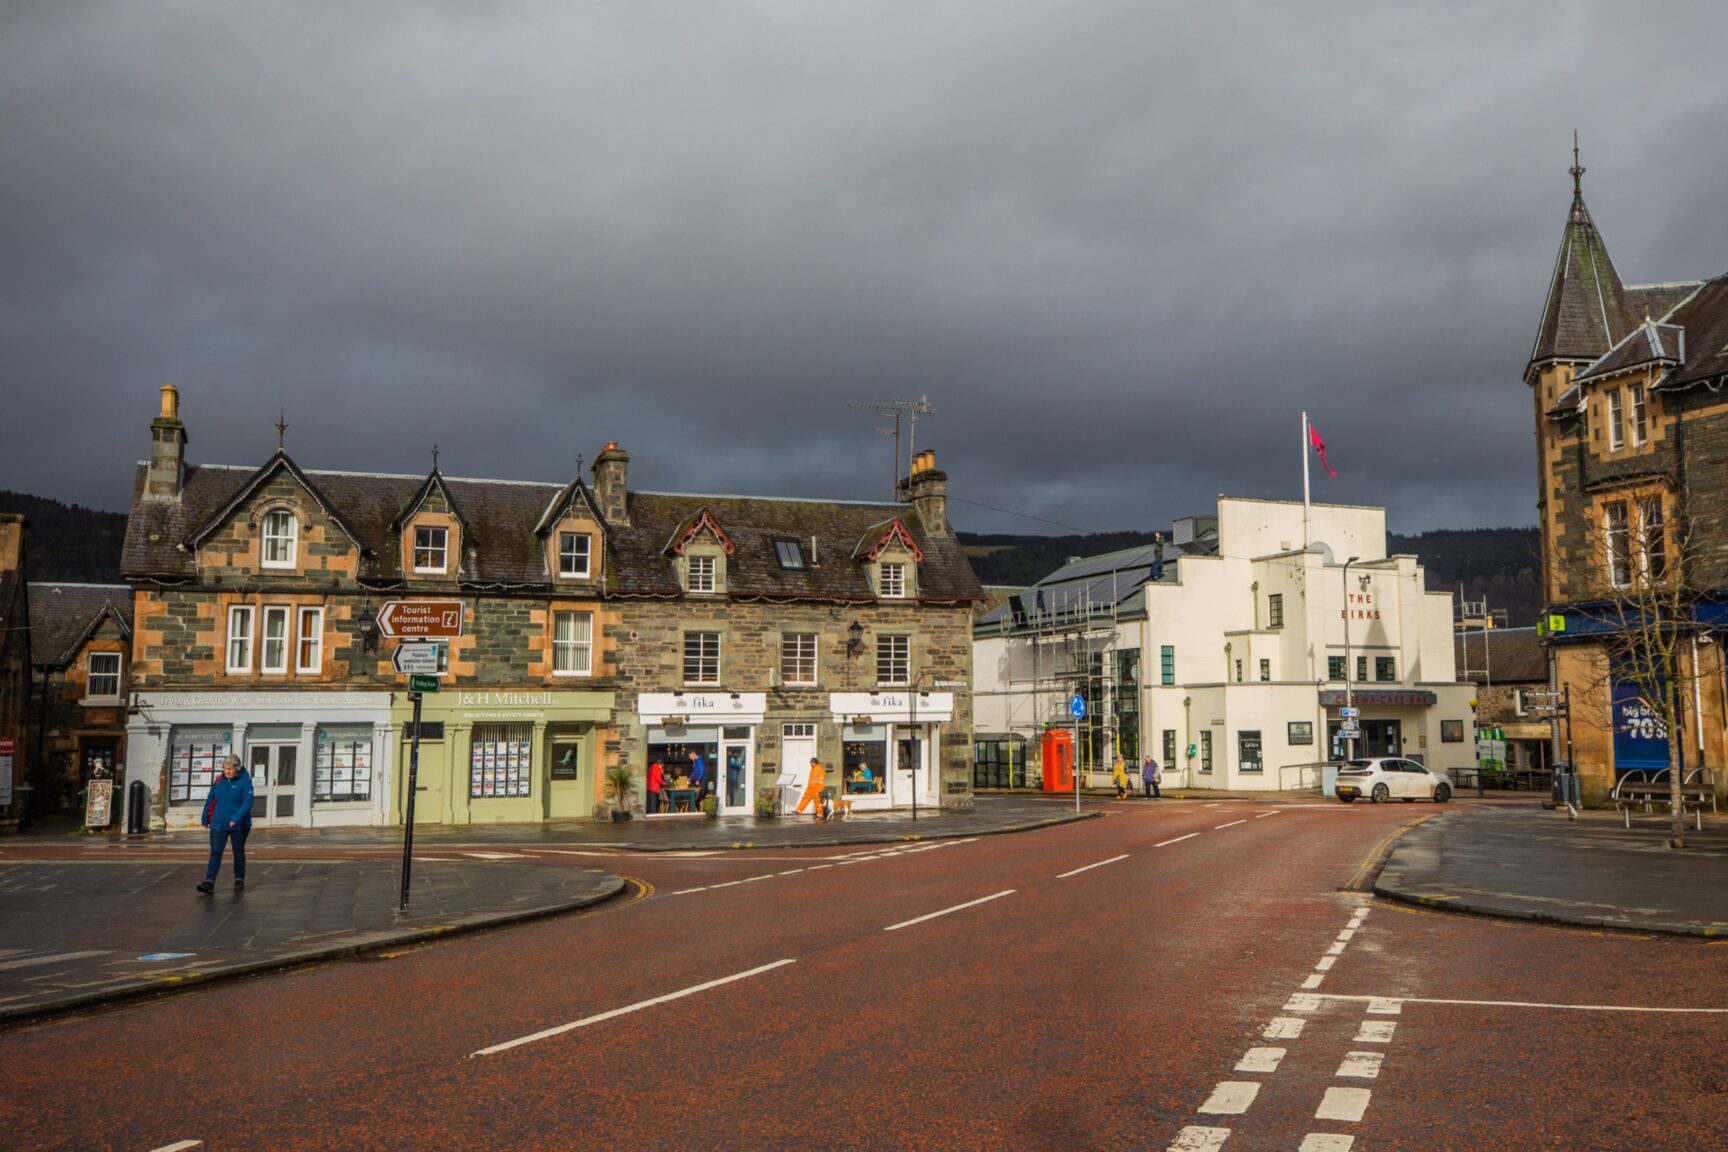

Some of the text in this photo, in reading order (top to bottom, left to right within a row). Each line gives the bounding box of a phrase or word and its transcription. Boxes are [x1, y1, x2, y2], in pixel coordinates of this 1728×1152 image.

[1348, 594, 1371, 604] THE
[402, 605, 432, 614] Tourist
[391, 615, 441, 624] information
[401, 625, 430, 633] centre
[457, 692, 551, 708] J&H Mitchell
[693, 696, 714, 708] fika
[883, 695, 903, 707] fika
[1622, 706, 1639, 718] big
